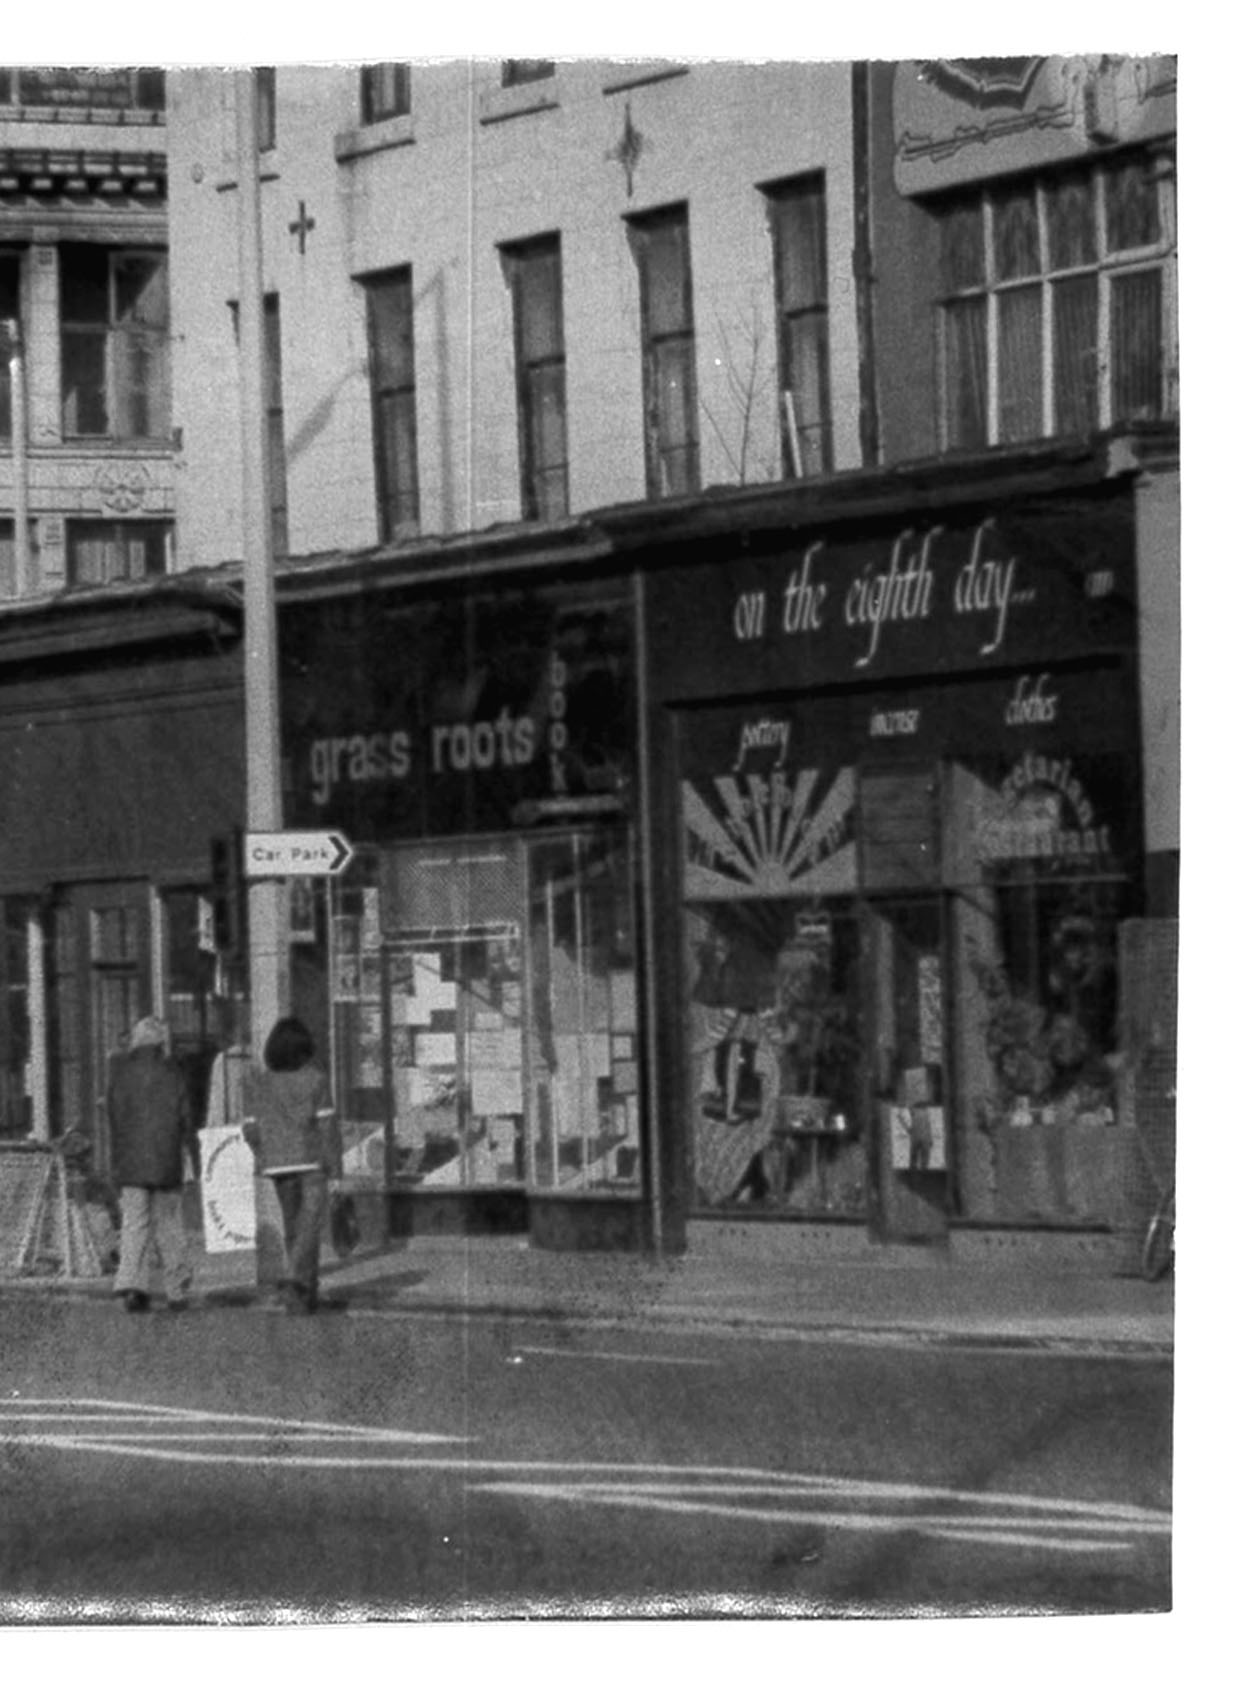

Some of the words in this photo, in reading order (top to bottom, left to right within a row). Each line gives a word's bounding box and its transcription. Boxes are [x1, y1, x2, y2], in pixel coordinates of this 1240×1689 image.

[734, 591, 765, 640] on
[783, 540, 827, 635] the
[844, 524, 944, 668] eighth
[309, 729, 411, 805] grass
[433, 708, 535, 772] roots
[252, 847, 281, 862] Car
[291, 846, 329, 861] Park
